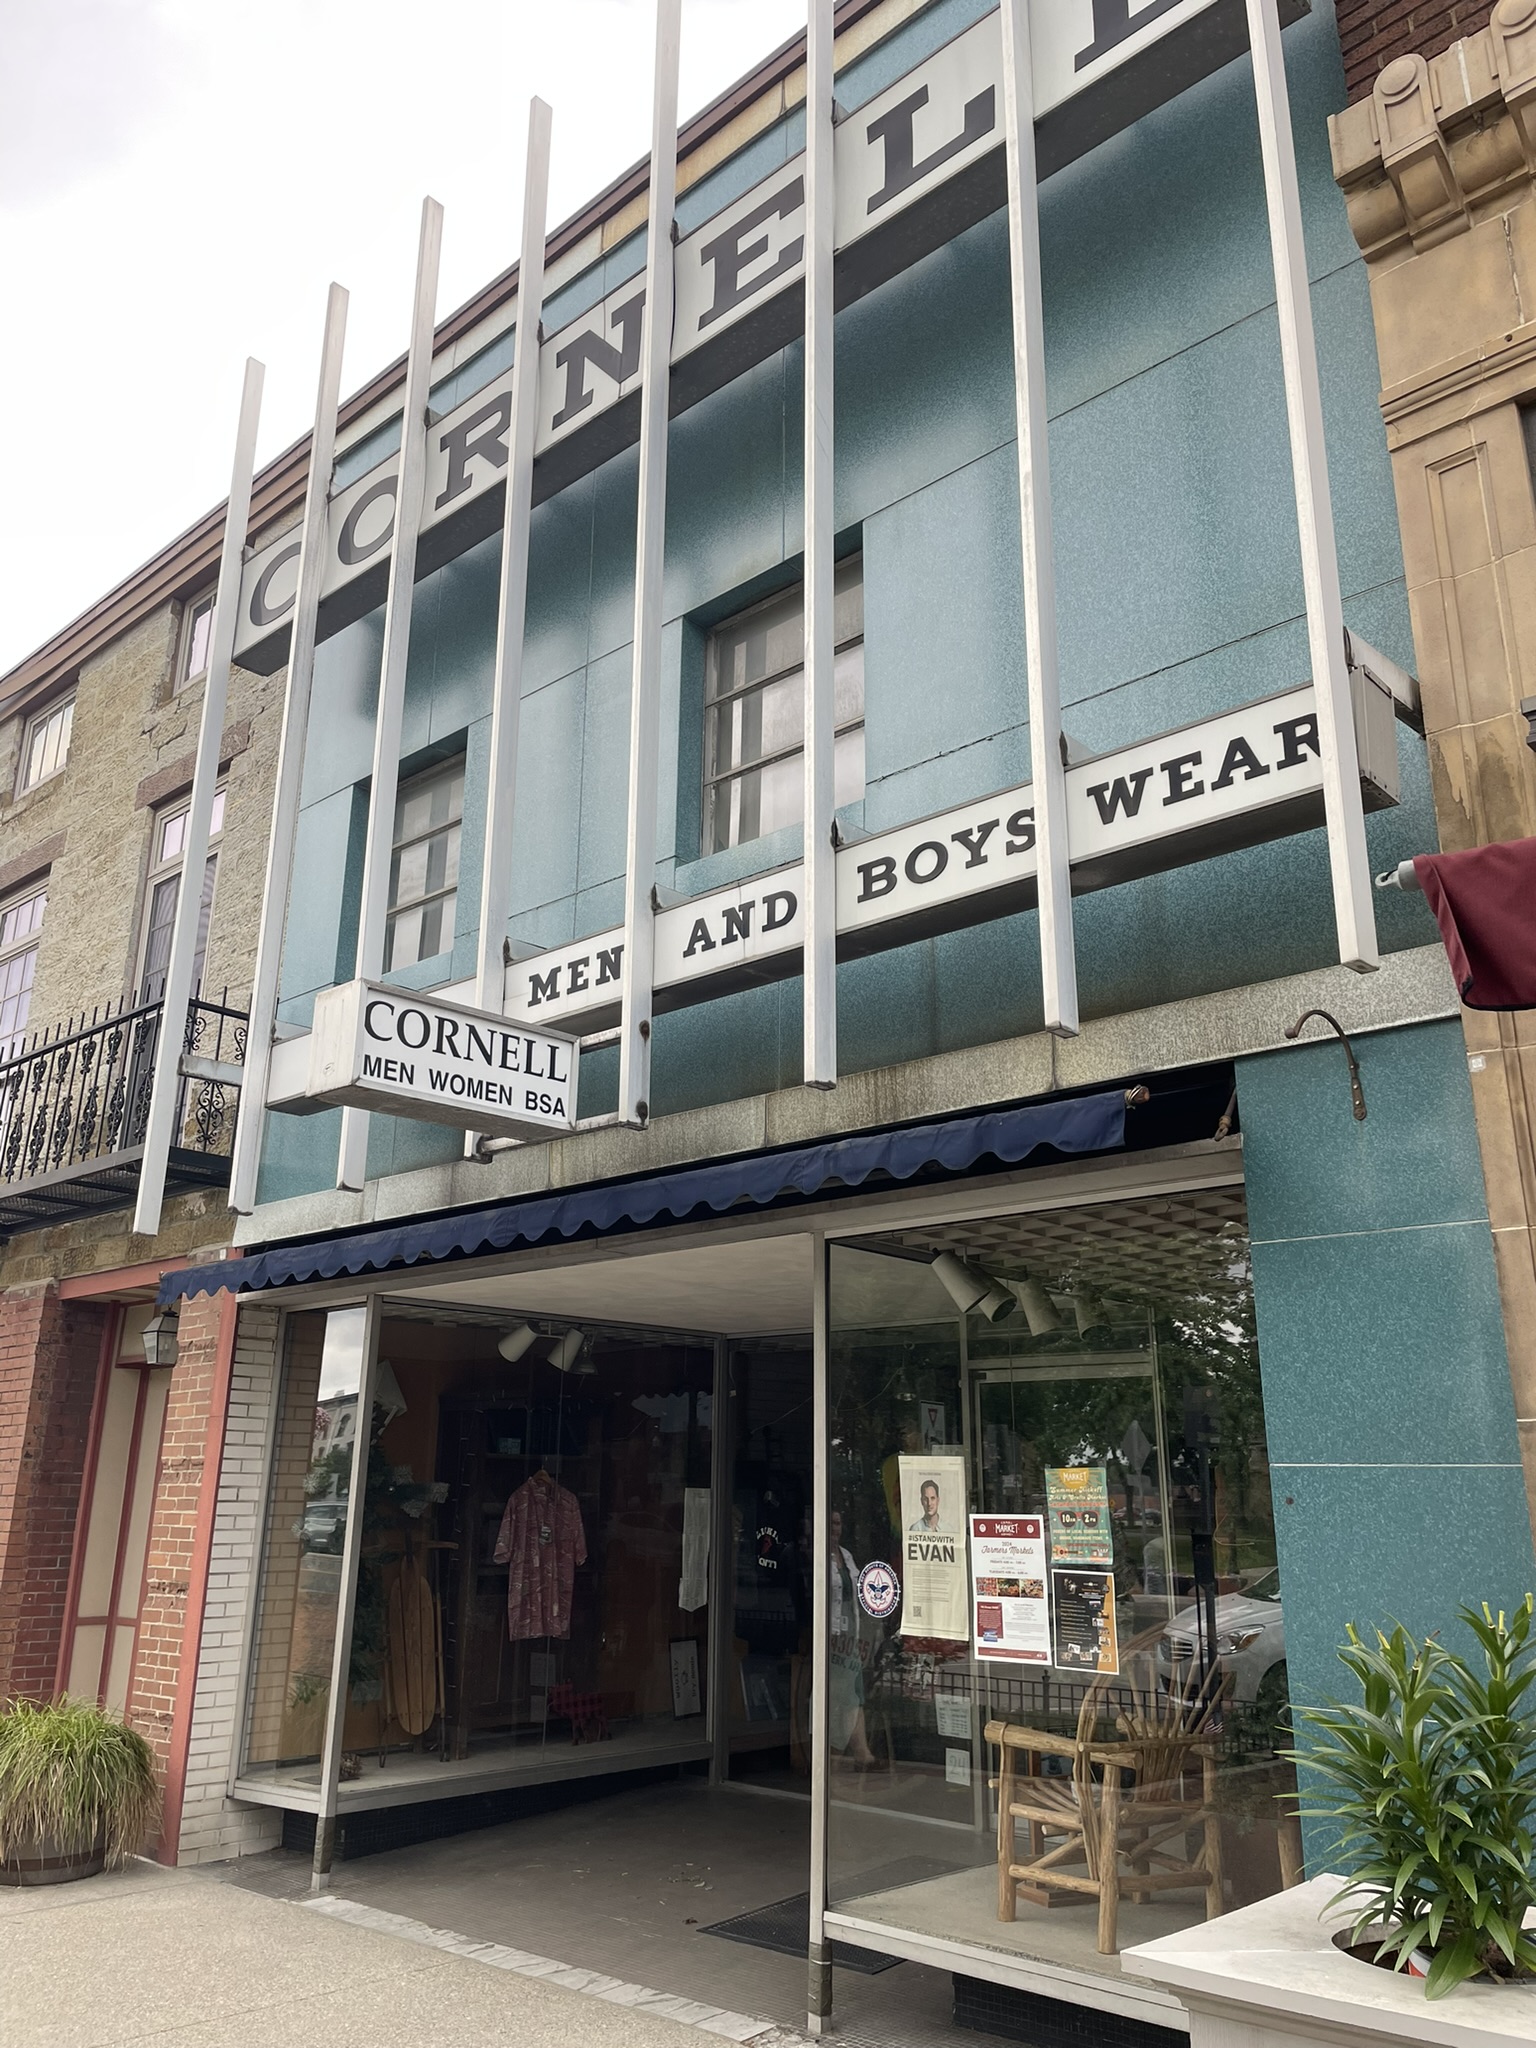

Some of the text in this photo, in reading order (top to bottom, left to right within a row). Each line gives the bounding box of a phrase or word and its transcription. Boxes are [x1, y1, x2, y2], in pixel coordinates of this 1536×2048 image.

[527, 713, 1322, 1007] MEN AND BOYS WEAR
[364, 1000, 568, 1083] CORNELL
[364, 1054, 566, 1117] MEN WOMEN BSA
[1063, 1472, 1087, 1482] MARKET
[908, 1534, 955, 1543] #ISTANDWITH
[995, 1523, 1019, 1534] MARKET
[908, 1543, 955, 1563] EVAN
